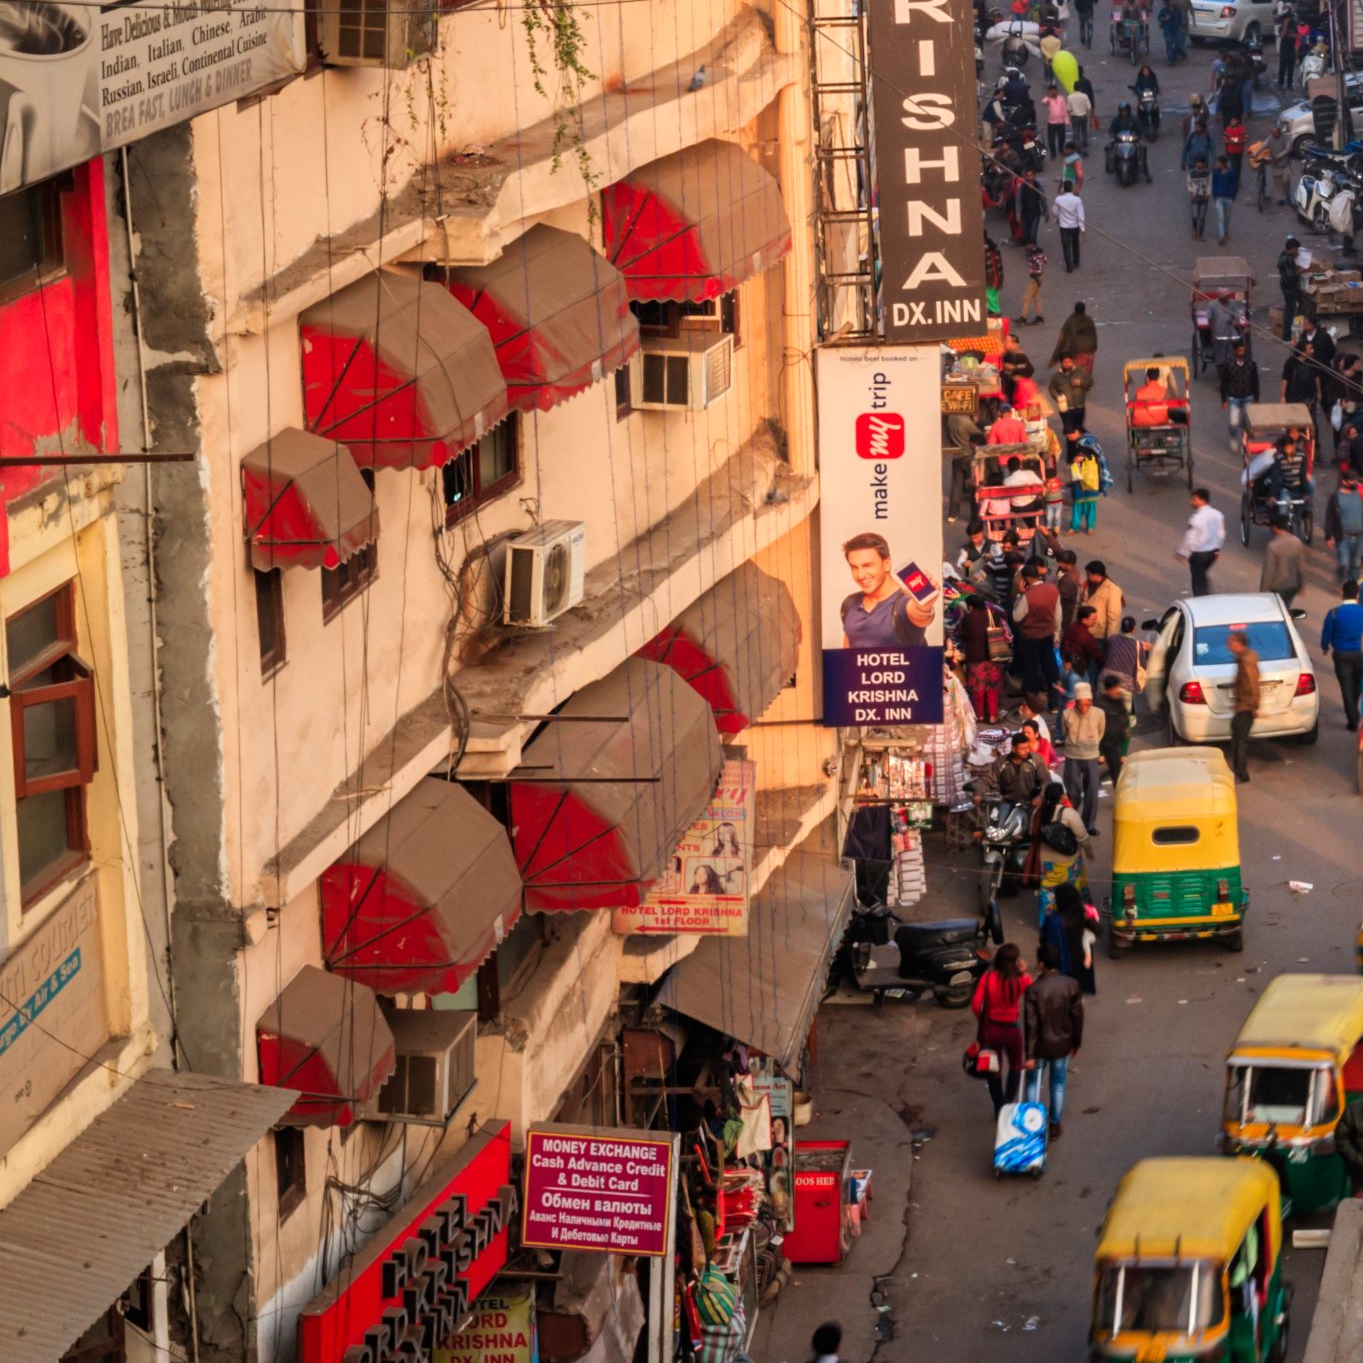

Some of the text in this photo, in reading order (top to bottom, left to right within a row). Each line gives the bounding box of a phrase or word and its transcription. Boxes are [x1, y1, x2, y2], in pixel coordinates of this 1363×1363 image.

[944, 389, 972, 401] CAFE
[868, 415, 903, 521] make my
[856, 652, 910, 667] HOTEL
[861, 670, 906, 685] LORD
[847, 688, 919, 705] KRISHNA
[855, 706, 912, 723] DX. INN
[621, 906, 743, 918] HOTEL LORD KRISHNA
[654, 917, 709, 926] 1st FLOOR
[543, 1139, 657, 1160] MONEY EXCHANGE
[532, 1154, 666, 1177] Cash Advance Credit
[571, 1174, 639, 1191] Debit Card
[541, 1192, 652, 1215] Обмен валюты
[529, 1210, 662, 1231] Аванс Наличными Кредитные
[610, 1231, 639, 1246] Карты
